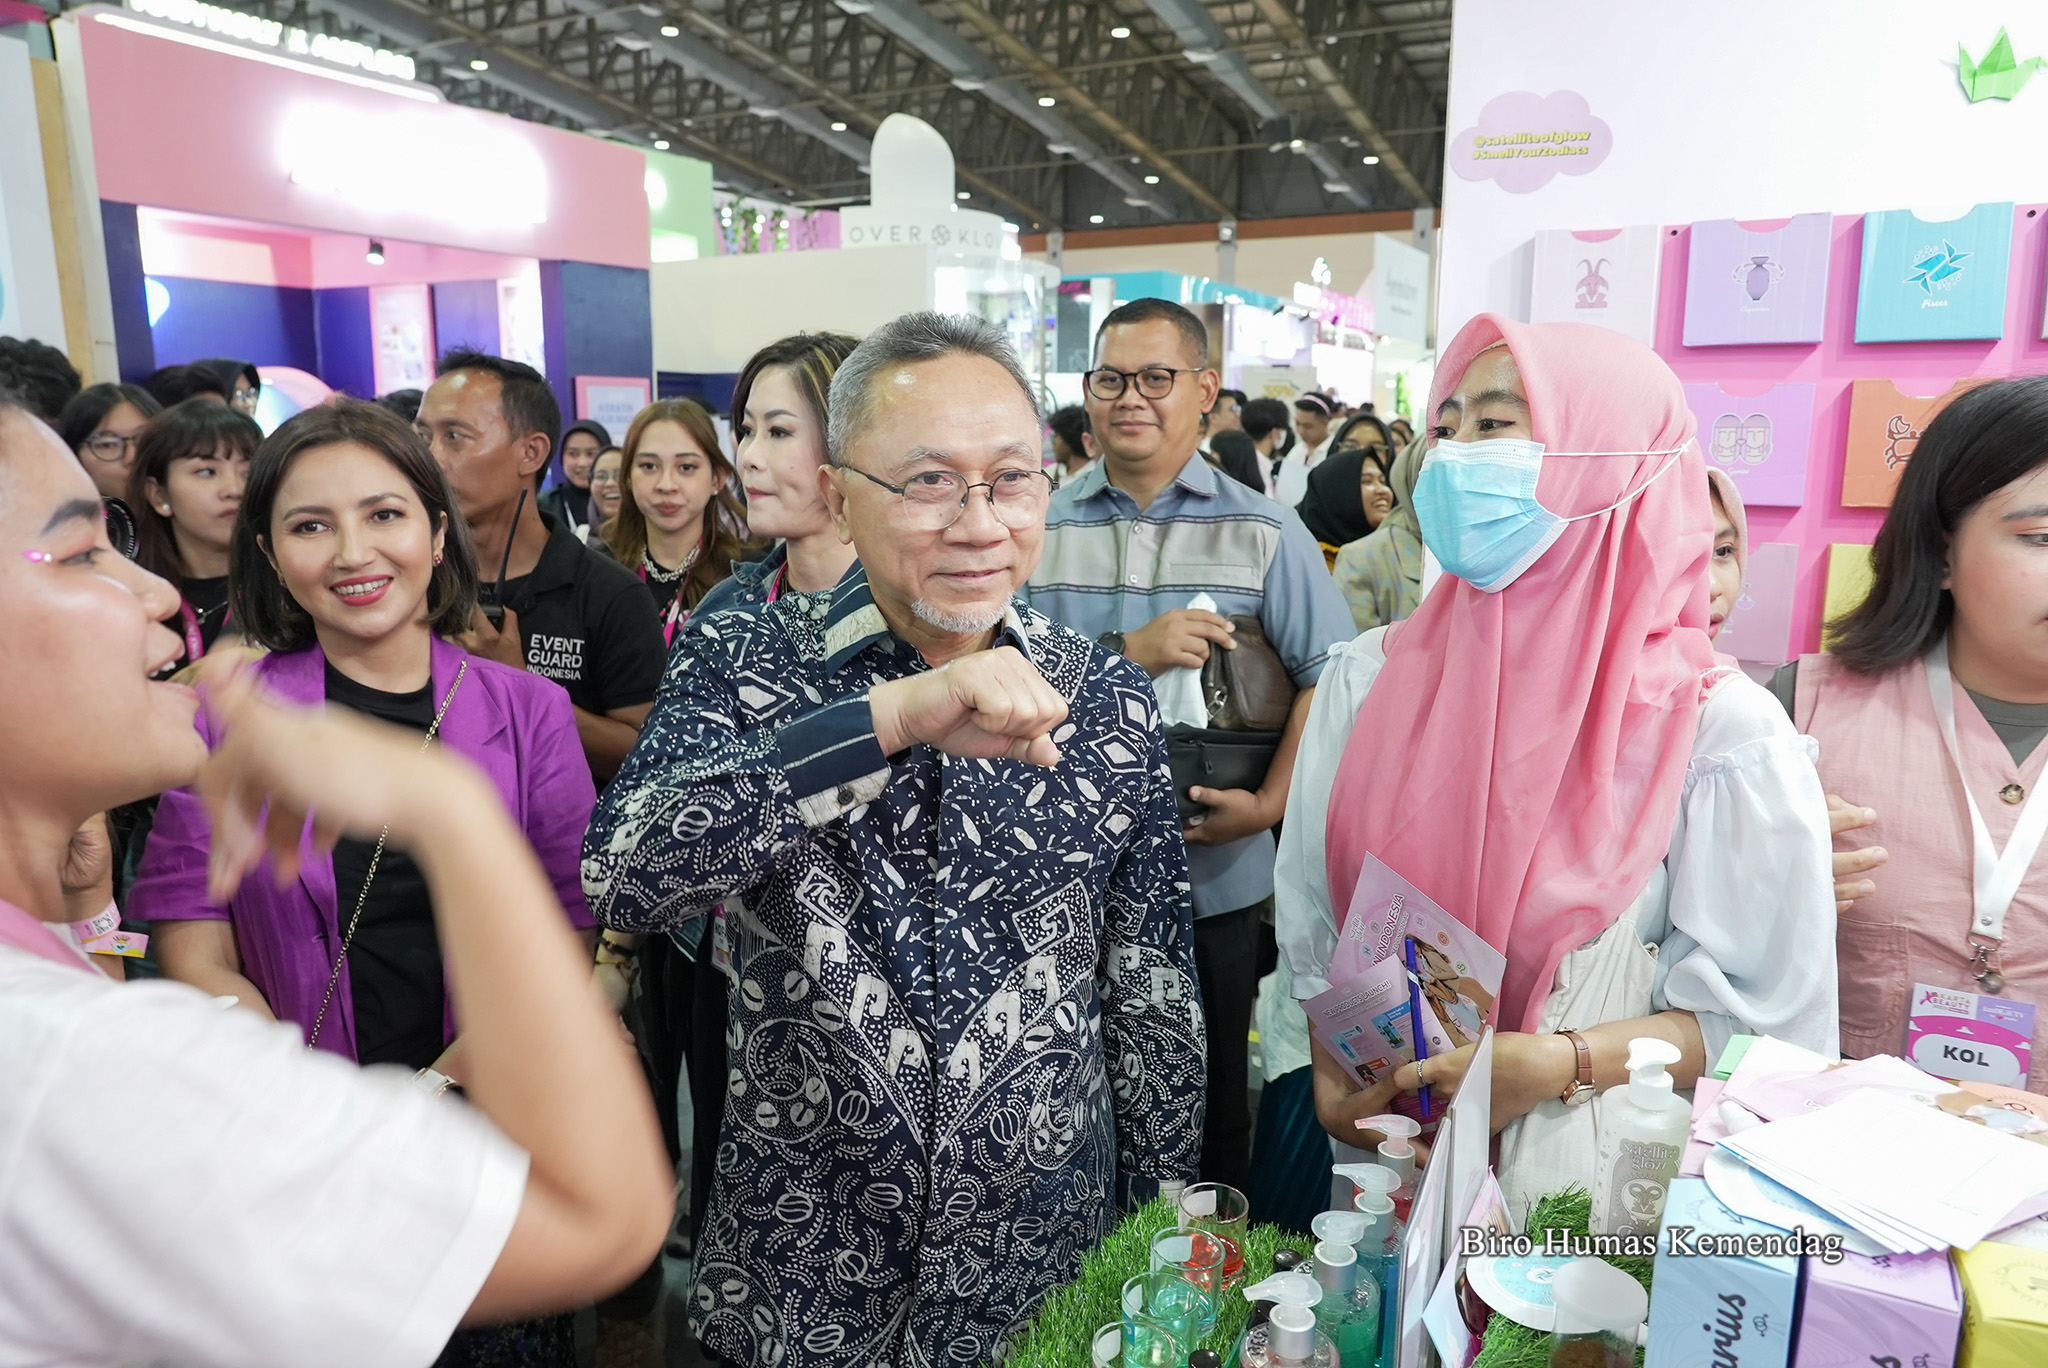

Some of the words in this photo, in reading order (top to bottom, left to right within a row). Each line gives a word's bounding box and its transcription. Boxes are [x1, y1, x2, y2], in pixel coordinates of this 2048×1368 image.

[1474, 131, 1591, 147] @satelliteofglow
[1473, 146, 1589, 160] #SmellYourZodiacs
[841, 225, 922, 243] OVER
[958, 228, 1001, 249] KLO
[530, 633, 585, 654] EVENT
[527, 649, 583, 669] GUARD
[526, 664, 582, 680] INDONESIA
[1376, 894, 1405, 958] INDONESIA
[1362, 979, 1392, 1001] LAUNCH!
[1943, 1044, 1990, 1067] KOL
